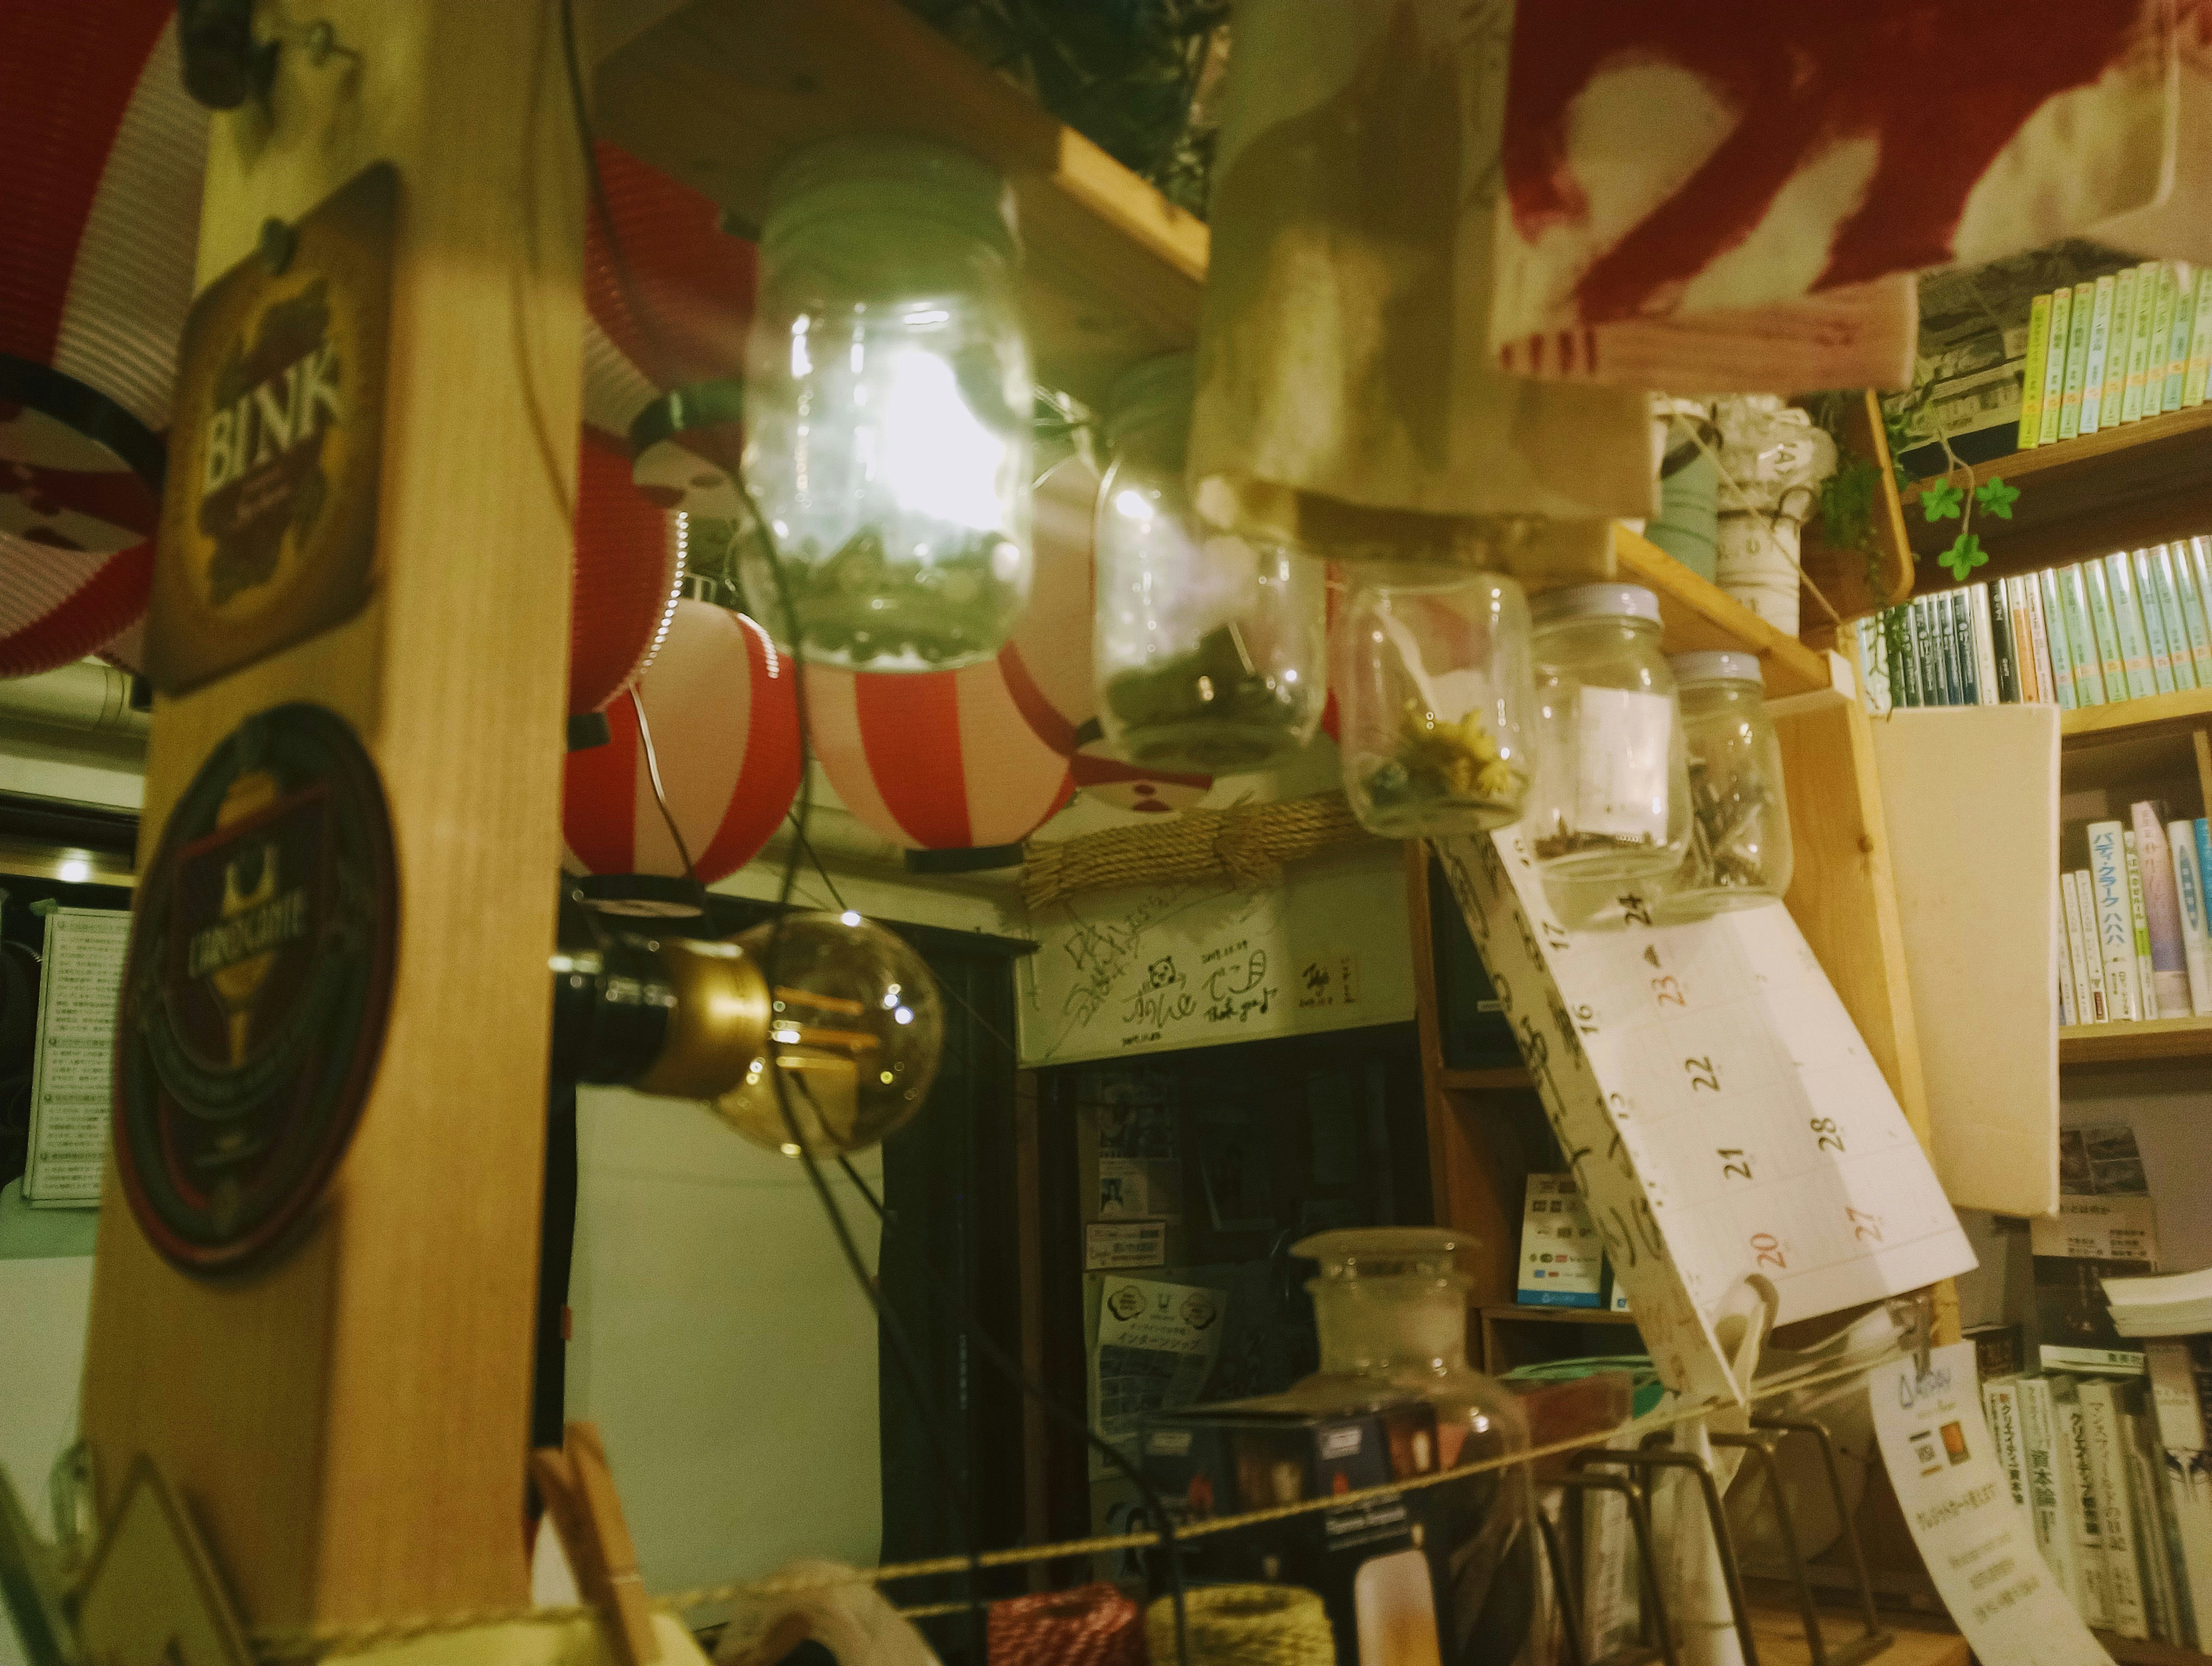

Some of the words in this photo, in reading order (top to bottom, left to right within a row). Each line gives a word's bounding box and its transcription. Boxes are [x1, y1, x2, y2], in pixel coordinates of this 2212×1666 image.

[204, 344, 345, 492] BINK
[1618, 892, 1653, 926] 24
[1541, 920, 1571, 952] 17
[1650, 974, 1687, 1007] 23
[1572, 1003, 1599, 1036] 16
[1684, 1054, 1721, 1093] 22
[1809, 1116, 1847, 1153] 28
[1715, 1147, 1754, 1181] 21
[1845, 1205, 1884, 1243] 27
[1750, 1232, 1786, 1270] 20
